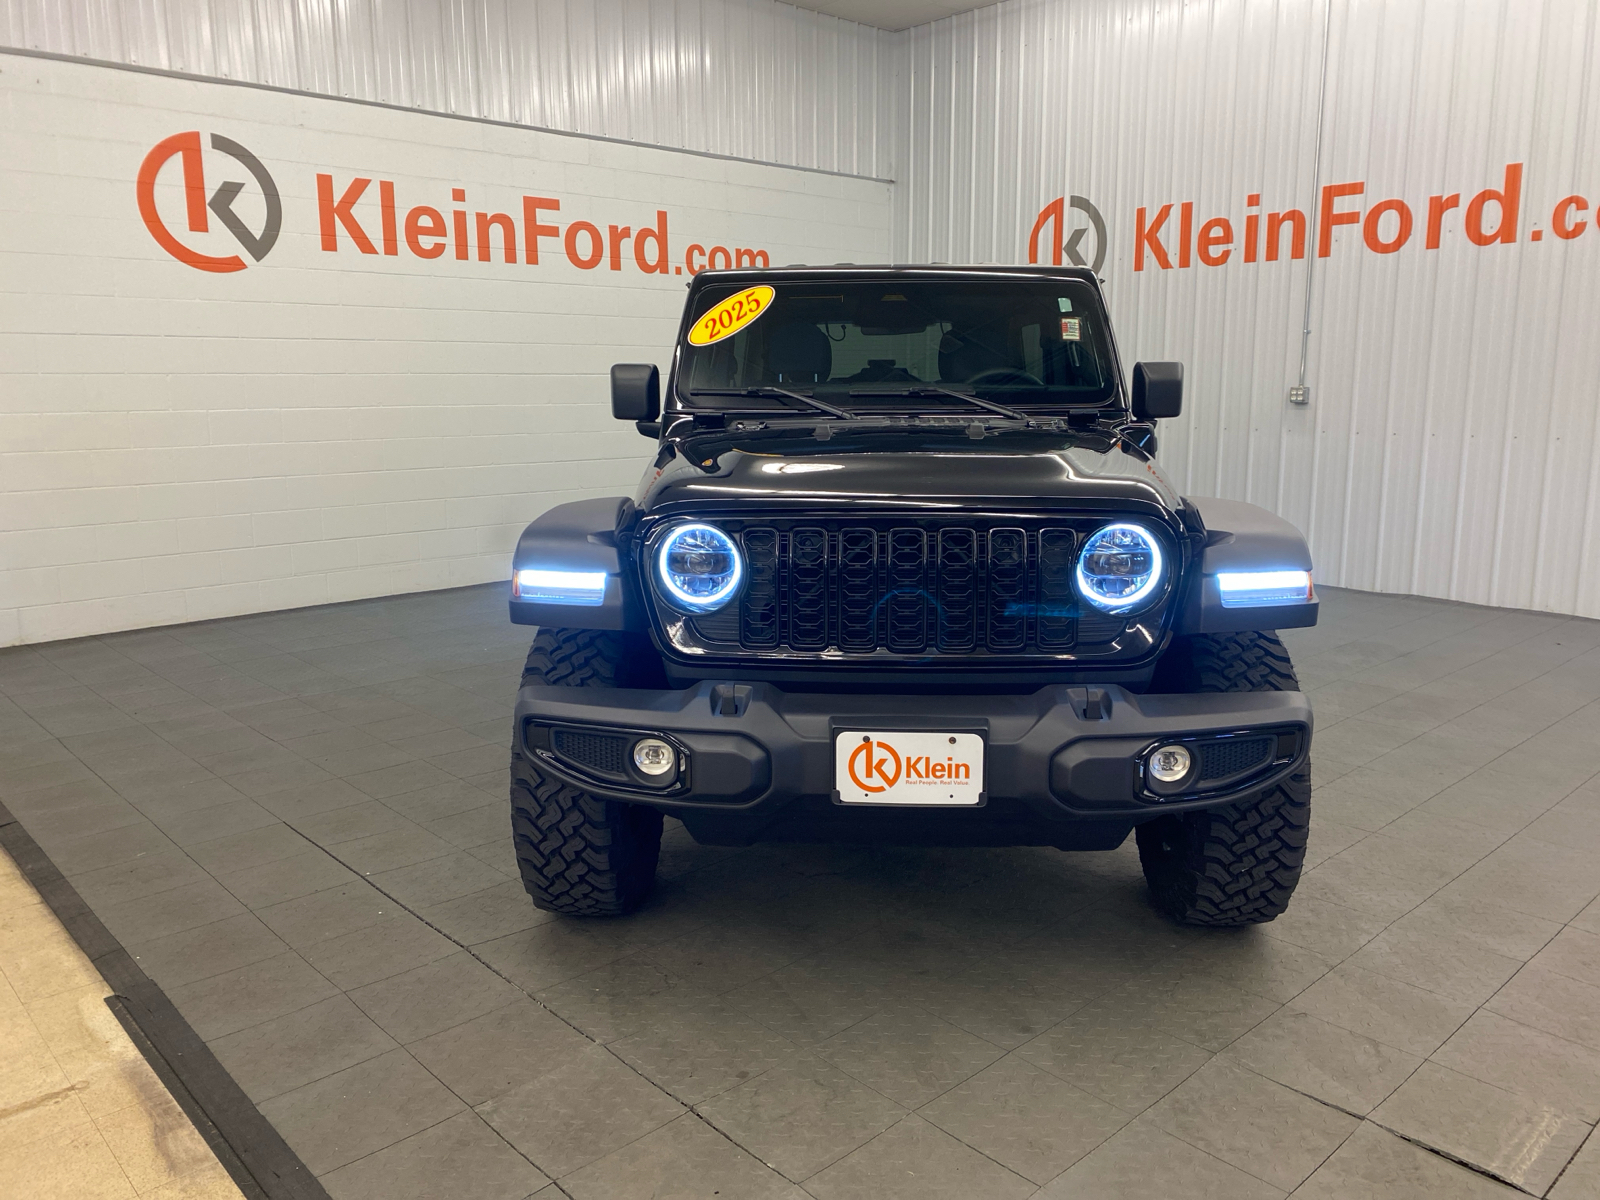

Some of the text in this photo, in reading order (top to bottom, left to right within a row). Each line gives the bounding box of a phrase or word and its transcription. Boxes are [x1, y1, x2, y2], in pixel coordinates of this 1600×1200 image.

[315, 172, 770, 277] KleinFord.com
[1132, 161, 1600, 272] KleinFord.c
[704, 290, 761, 340] 2025
[906, 756, 970, 779] Klein
